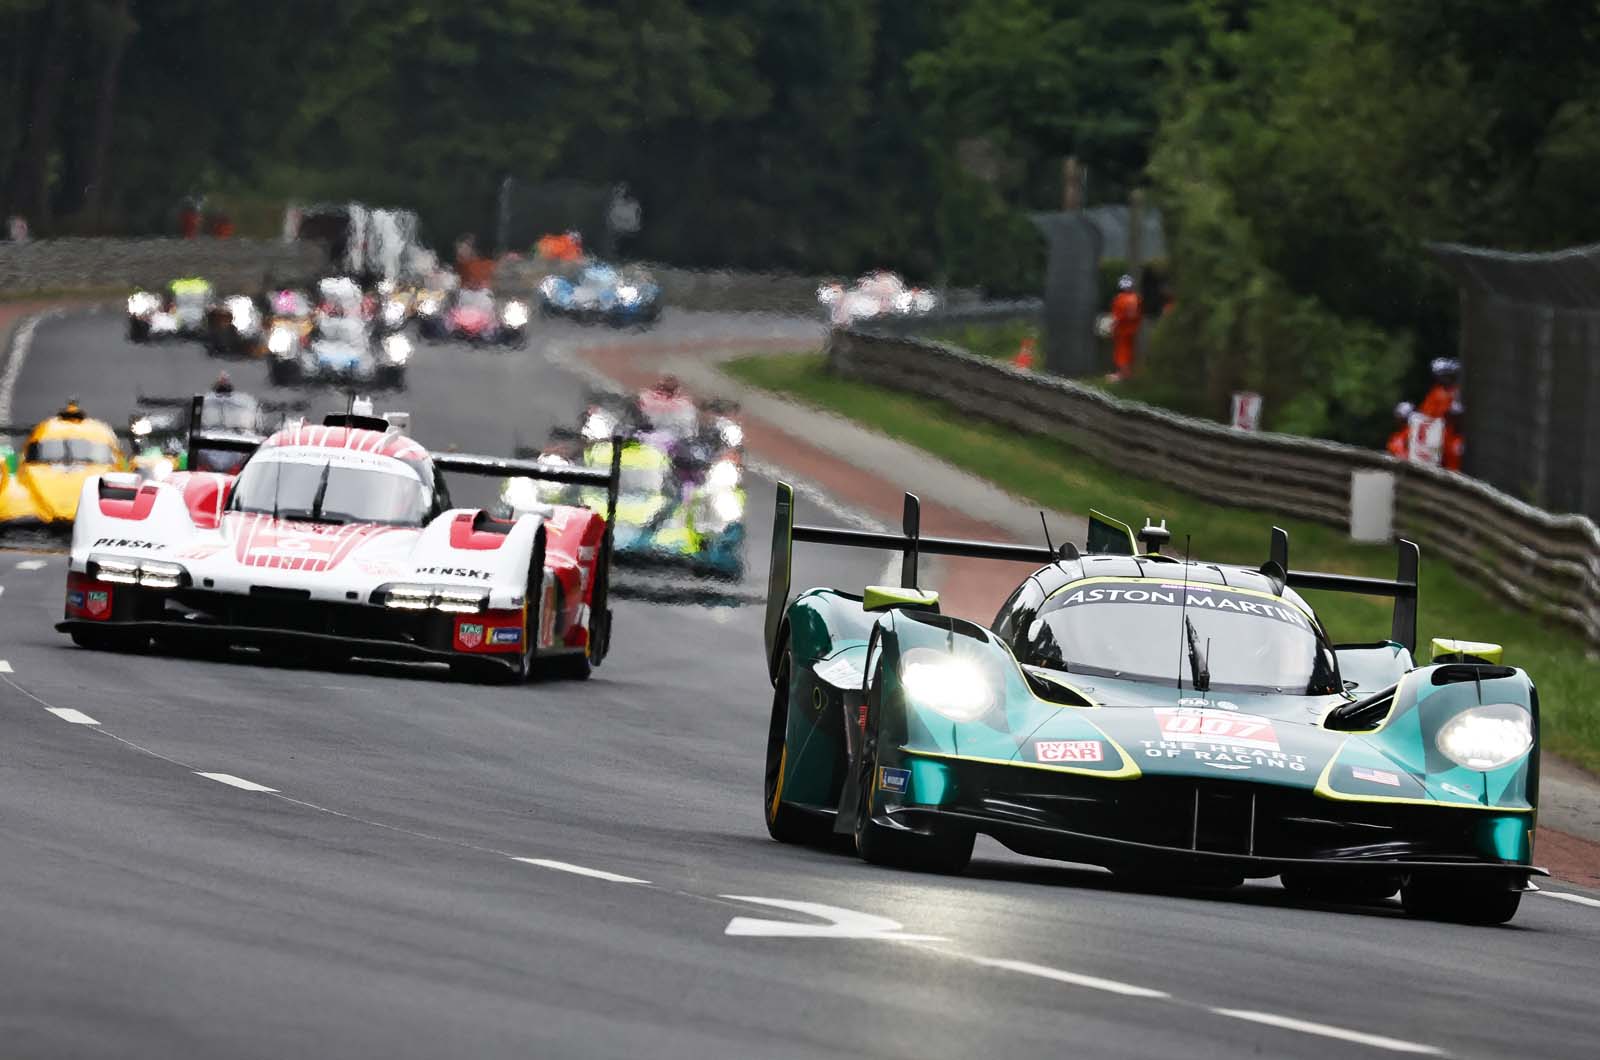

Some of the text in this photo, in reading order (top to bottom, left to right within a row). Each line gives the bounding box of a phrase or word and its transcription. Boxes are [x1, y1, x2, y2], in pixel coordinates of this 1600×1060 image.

[416, 567, 494, 580] PENSKE
[1063, 589, 1307, 628] ASTON MARTIN
[462, 624, 482, 633] TAG
[1165, 716, 1266, 736] 007
[1041, 749, 1097, 759] CAR
[1139, 740, 1307, 763] THE HEART
[1145, 749, 1306, 772] OF RACING
